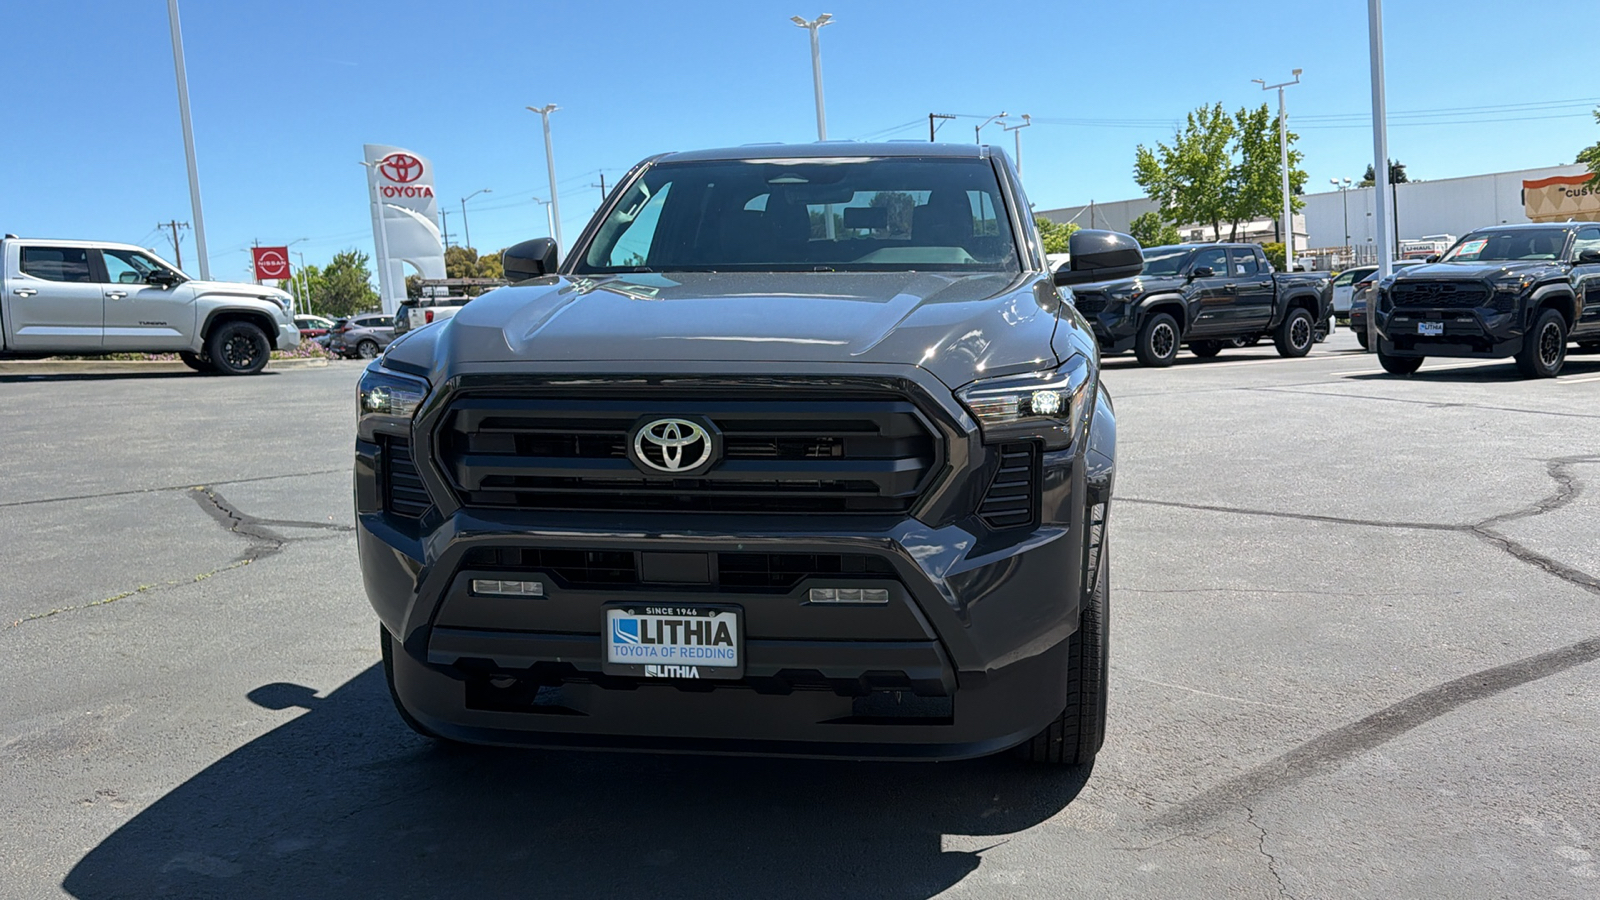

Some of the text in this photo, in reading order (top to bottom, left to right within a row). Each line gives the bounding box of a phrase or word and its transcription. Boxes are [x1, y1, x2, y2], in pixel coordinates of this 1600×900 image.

[646, 607, 697, 616] SINCE 1946
[640, 619, 733, 646] LITHIA
[613, 645, 734, 659] TOYOTA OF REDDING
[657, 665, 699, 679] LITHIA
